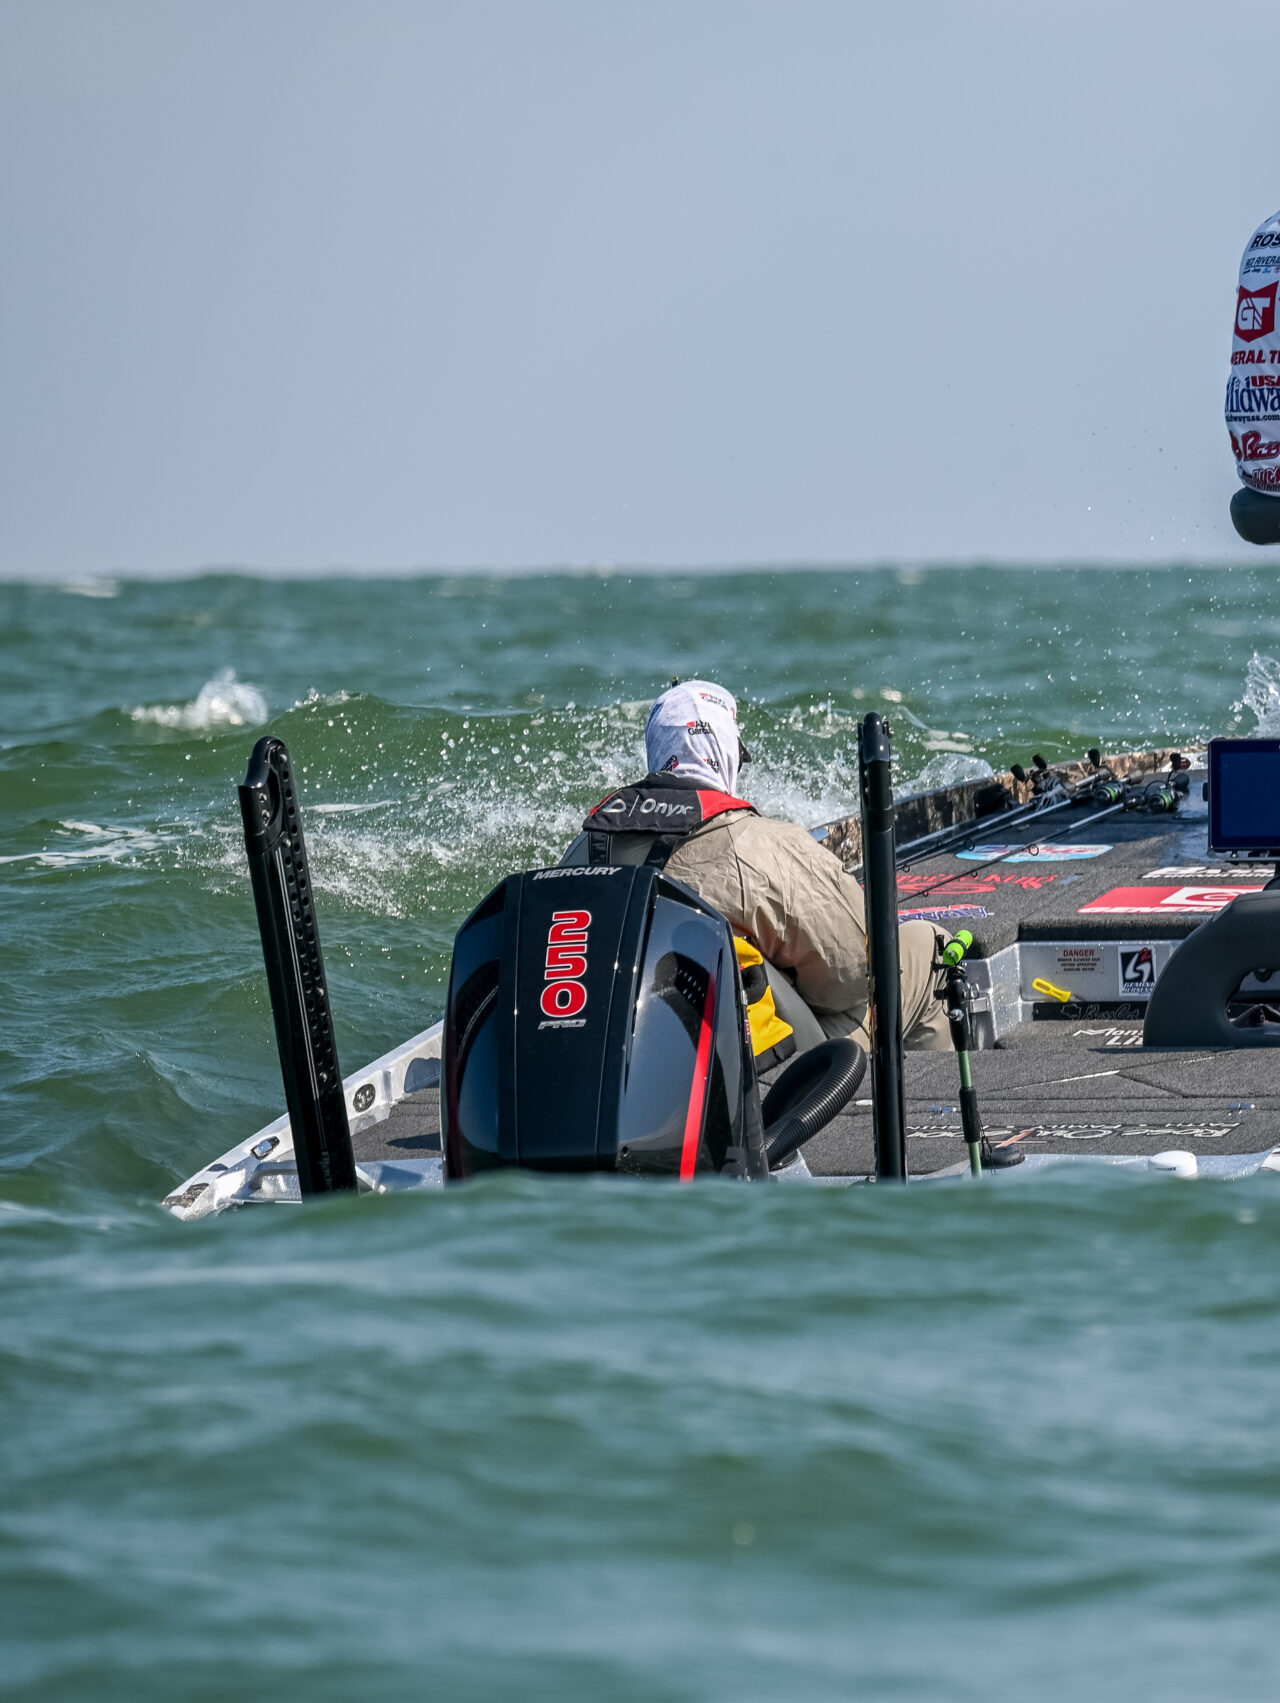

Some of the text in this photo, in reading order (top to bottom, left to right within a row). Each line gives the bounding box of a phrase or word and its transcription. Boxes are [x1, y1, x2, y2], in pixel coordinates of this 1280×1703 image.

[639, 798, 694, 817] Onyx
[532, 866, 623, 881] MERCURY
[1063, 949, 1095, 957] DANGER
[540, 910, 592, 1017] 250
